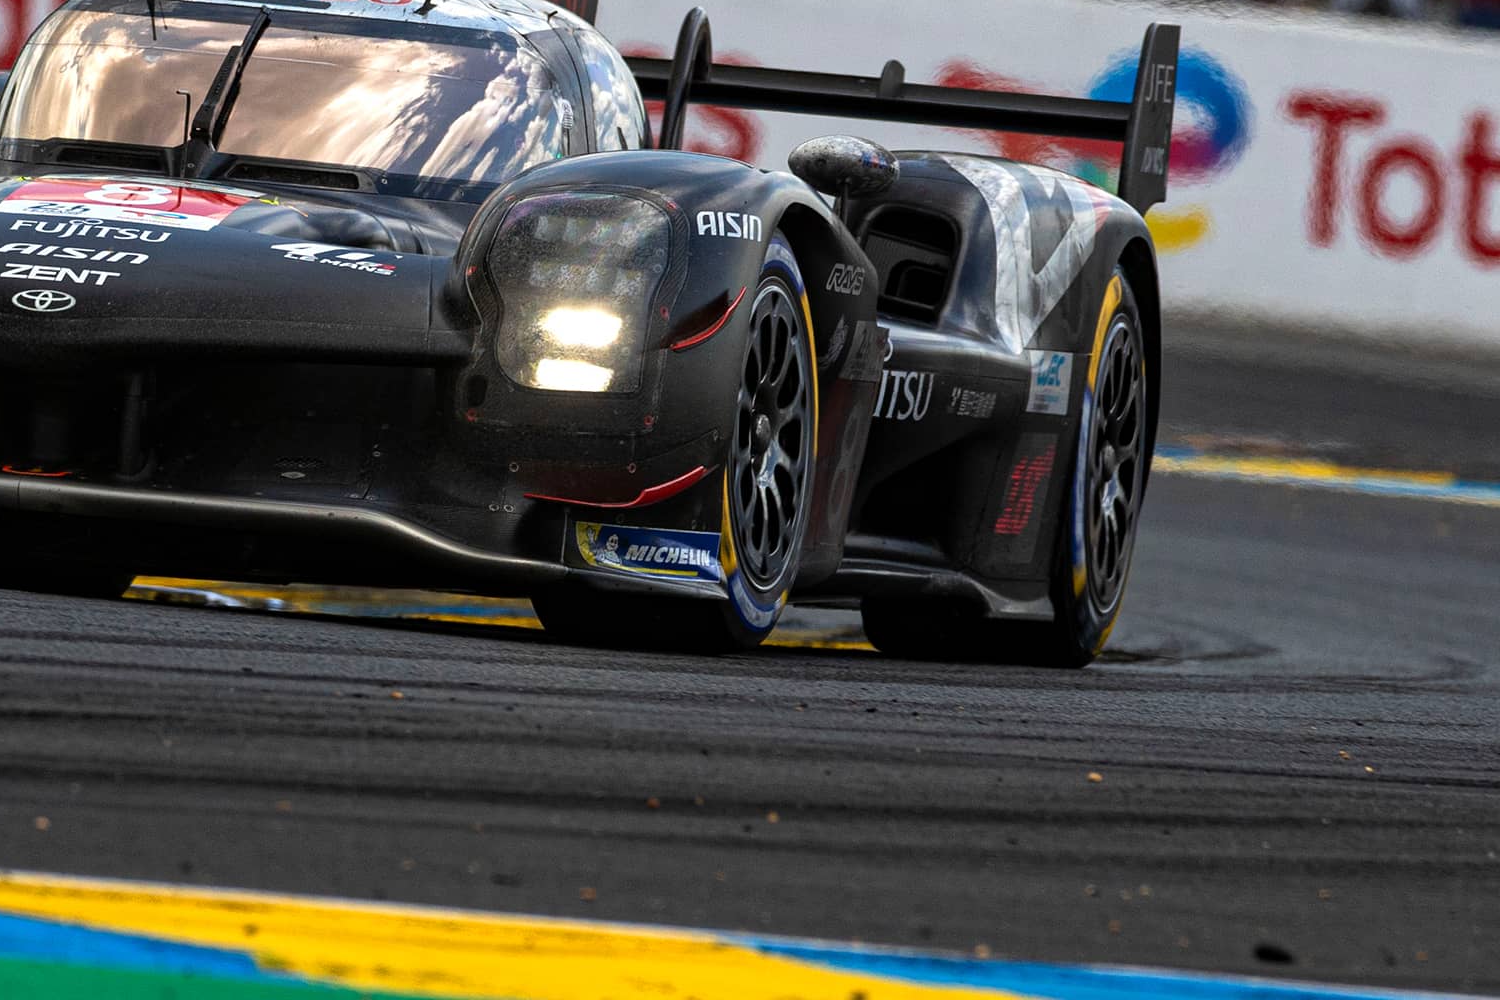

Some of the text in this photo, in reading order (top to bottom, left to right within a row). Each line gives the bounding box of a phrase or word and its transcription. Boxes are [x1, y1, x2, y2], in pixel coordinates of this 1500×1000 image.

[1145, 64, 1175, 103] JFE
[84, 183, 172, 206] 8
[10, 218, 172, 243] FUJITSU
[696, 210, 762, 242] AISIN
[0, 263, 121, 286] ZENT
[826, 263, 865, 295] RAYS
[625, 544, 711, 567] MICHELIN
